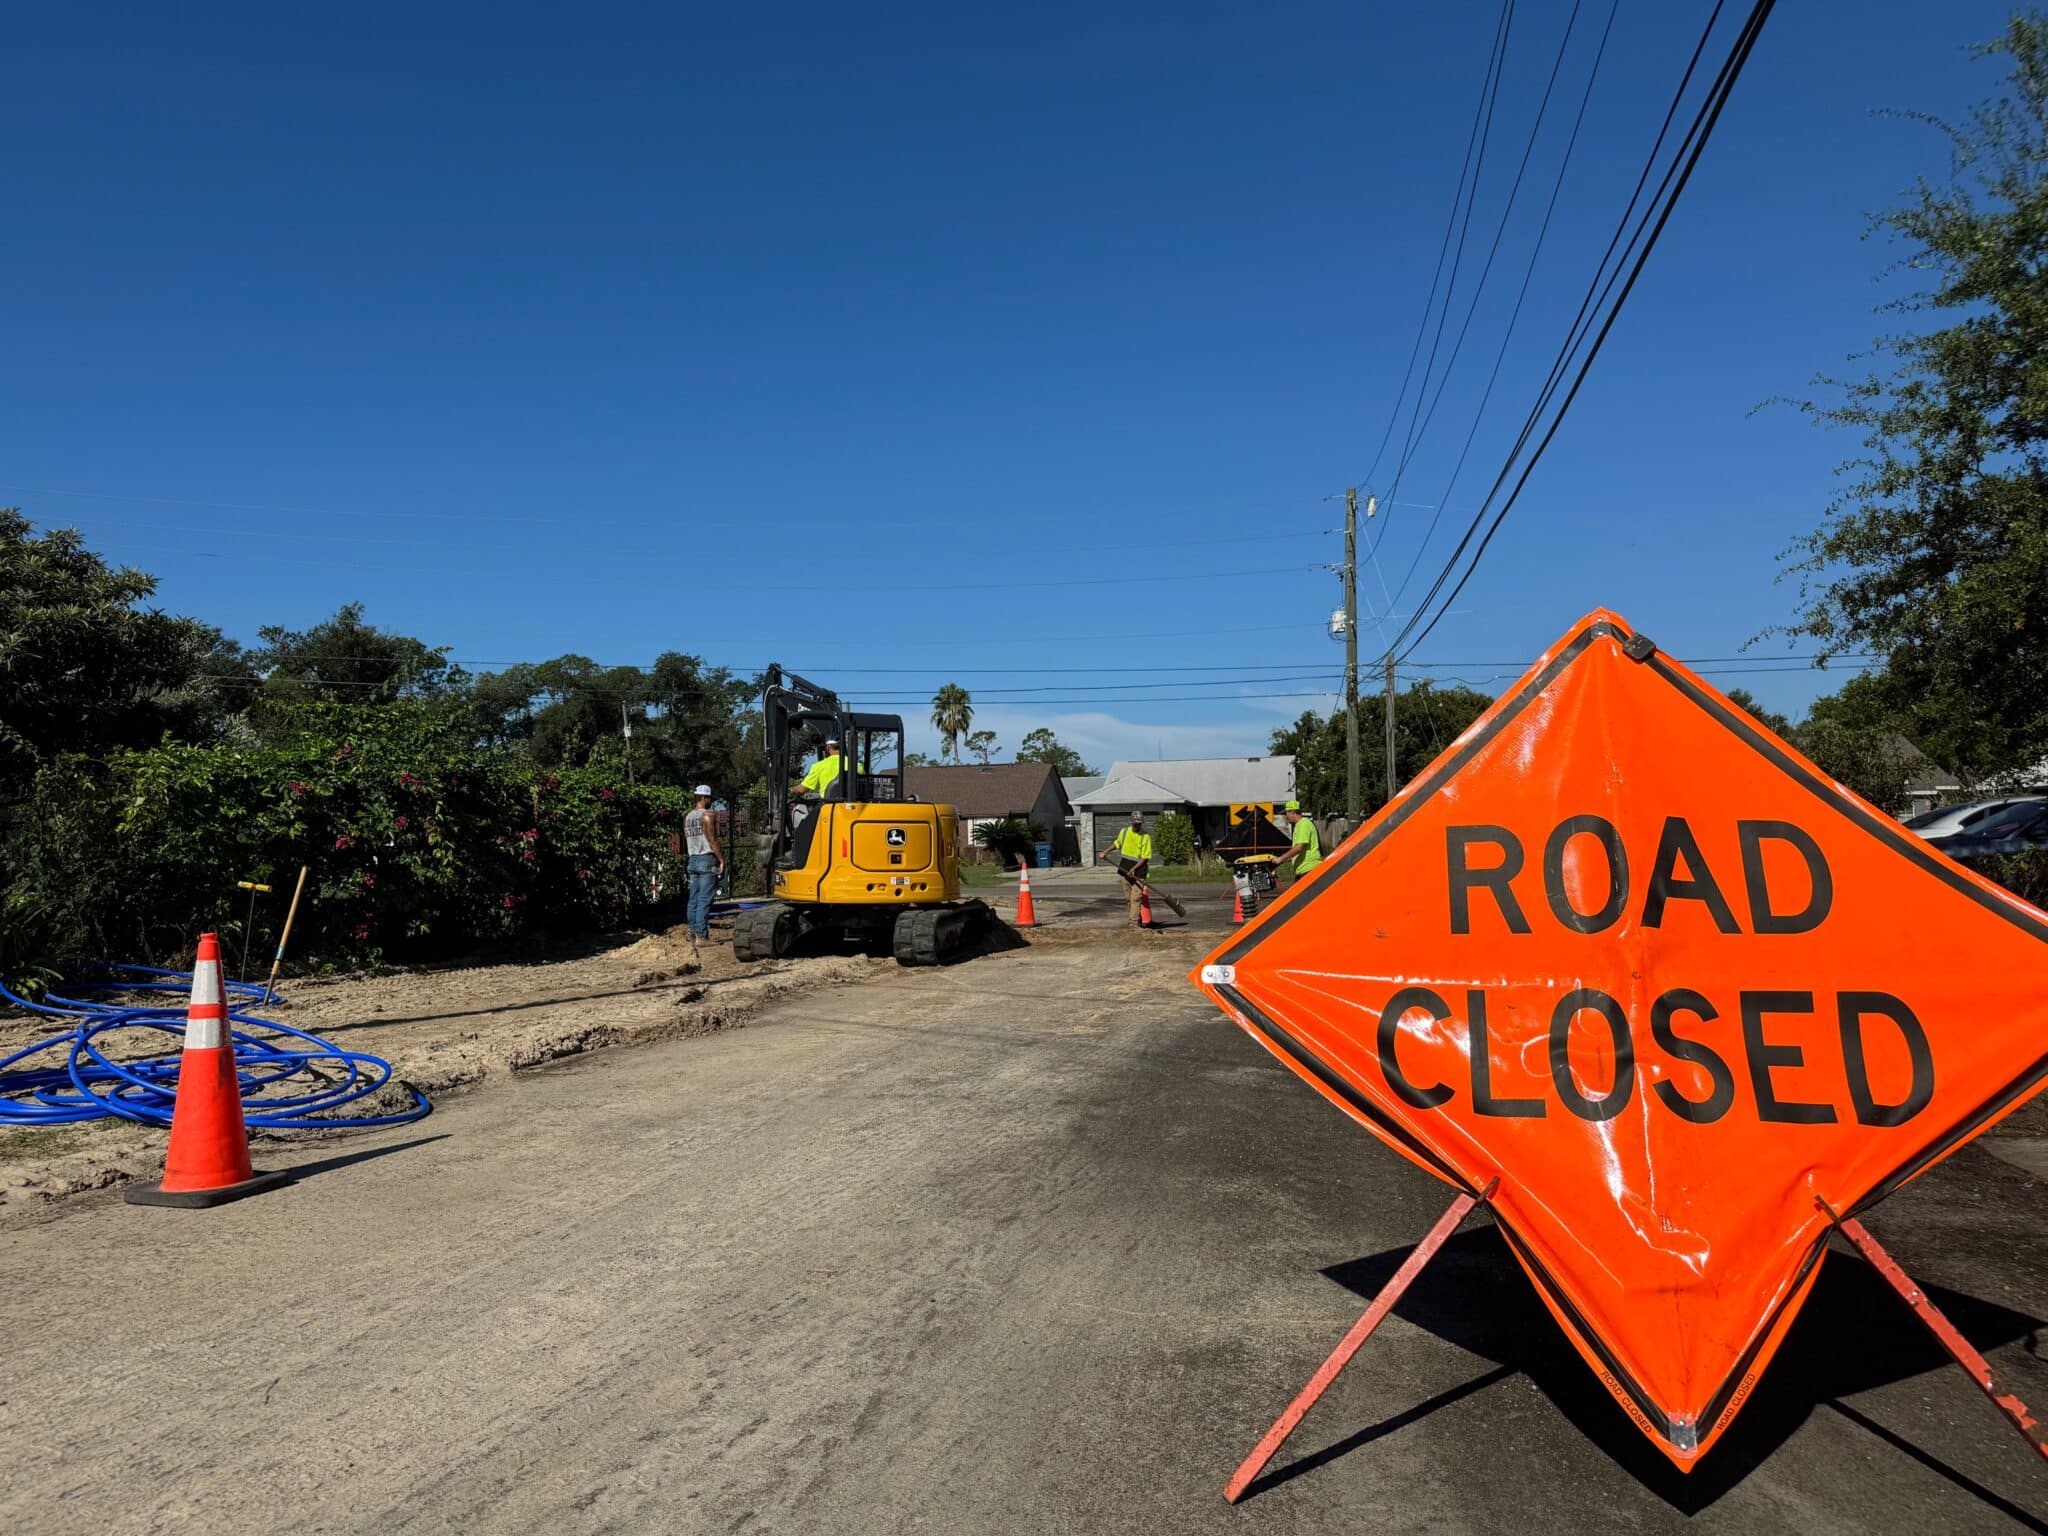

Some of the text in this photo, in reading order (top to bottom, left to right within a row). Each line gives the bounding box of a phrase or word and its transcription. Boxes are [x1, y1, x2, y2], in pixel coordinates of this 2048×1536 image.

[1445, 814, 1834, 935] ROAD
[1376, 986, 1935, 1128] CLOSED
[1601, 1370, 1652, 1433] ROAD CLOSED
[1716, 1373, 1756, 1430] ROAD CLOSED
